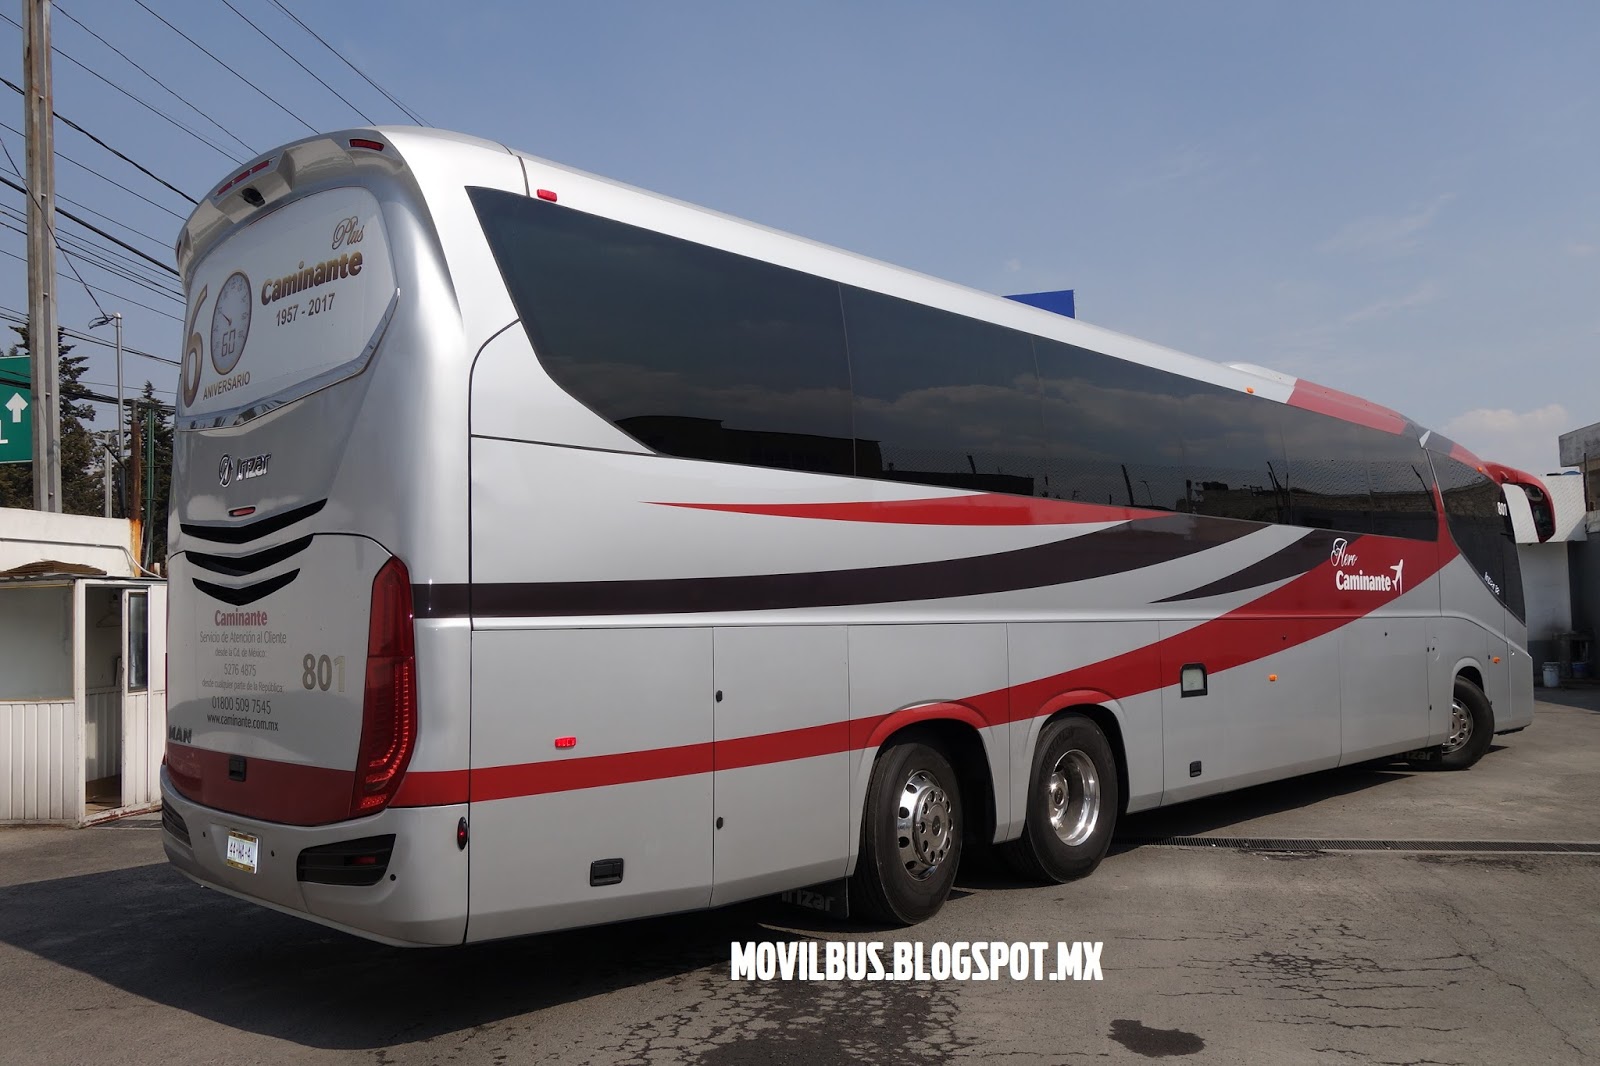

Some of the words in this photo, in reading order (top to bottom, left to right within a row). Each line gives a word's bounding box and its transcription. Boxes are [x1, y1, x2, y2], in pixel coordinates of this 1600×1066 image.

[332, 216, 365, 250] Plus
[261, 251, 363, 306] Caminante
[276, 304, 299, 327] 1957
[308, 293, 335, 316] 2017
[203, 371, 251, 400] ANIVERSARIO
[1331, 537, 1358, 567] Aero
[1336, 569, 1391, 591] Caminante
[214, 608, 268, 626] Caminante
[200, 631, 219, 643] Servicio
[221, 631, 228, 643] de
[229, 631, 255, 643] Atención
[257, 631, 263, 643] al
[264, 631, 287, 644] Cliente
[302, 653, 346, 692] 801
[212, 696, 234, 710] 01800
[235, 698, 249, 712] 509
[252, 700, 271, 714] 7545
[168, 725, 192, 743] MAN
[207, 714, 279, 731] www.caminante.com.mx
